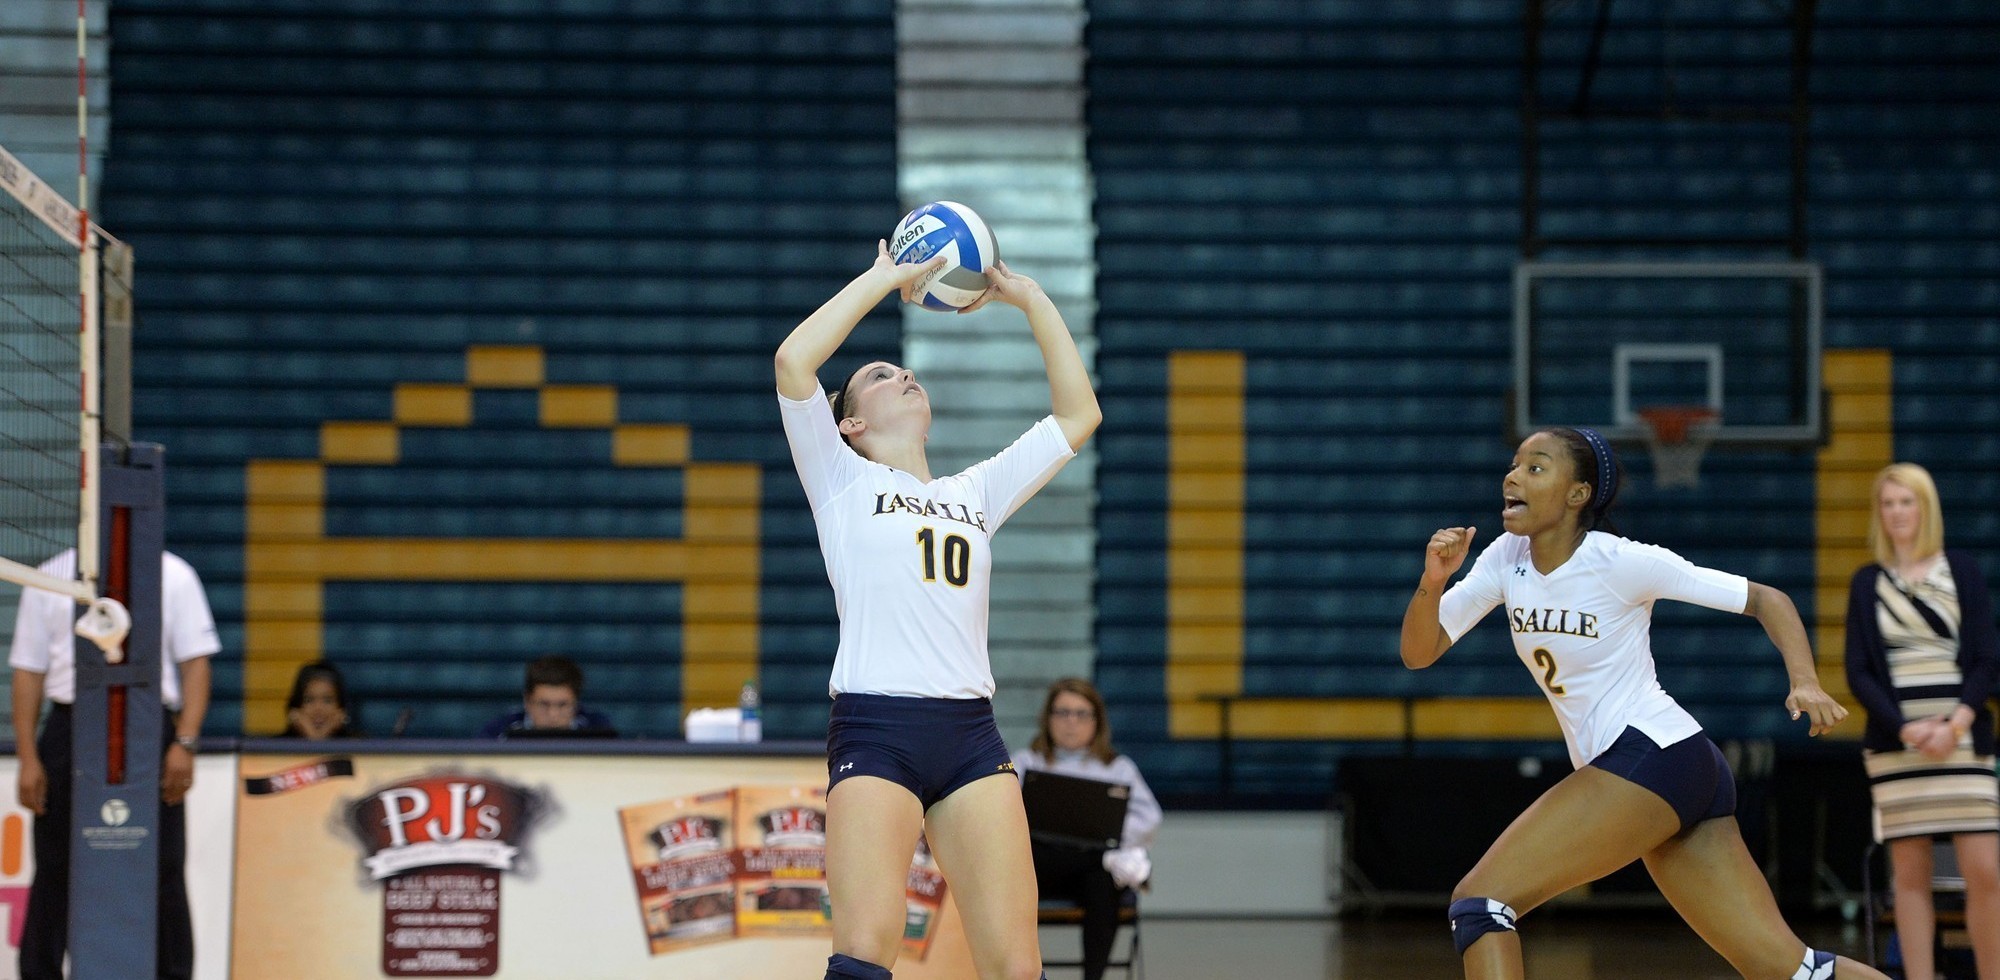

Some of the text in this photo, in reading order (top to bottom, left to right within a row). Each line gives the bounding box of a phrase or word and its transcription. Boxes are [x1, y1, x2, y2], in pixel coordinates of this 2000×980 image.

[916, 526, 971, 587] 10
[1533, 647, 1567, 697] 2
[379, 782, 502, 847] PJ's
